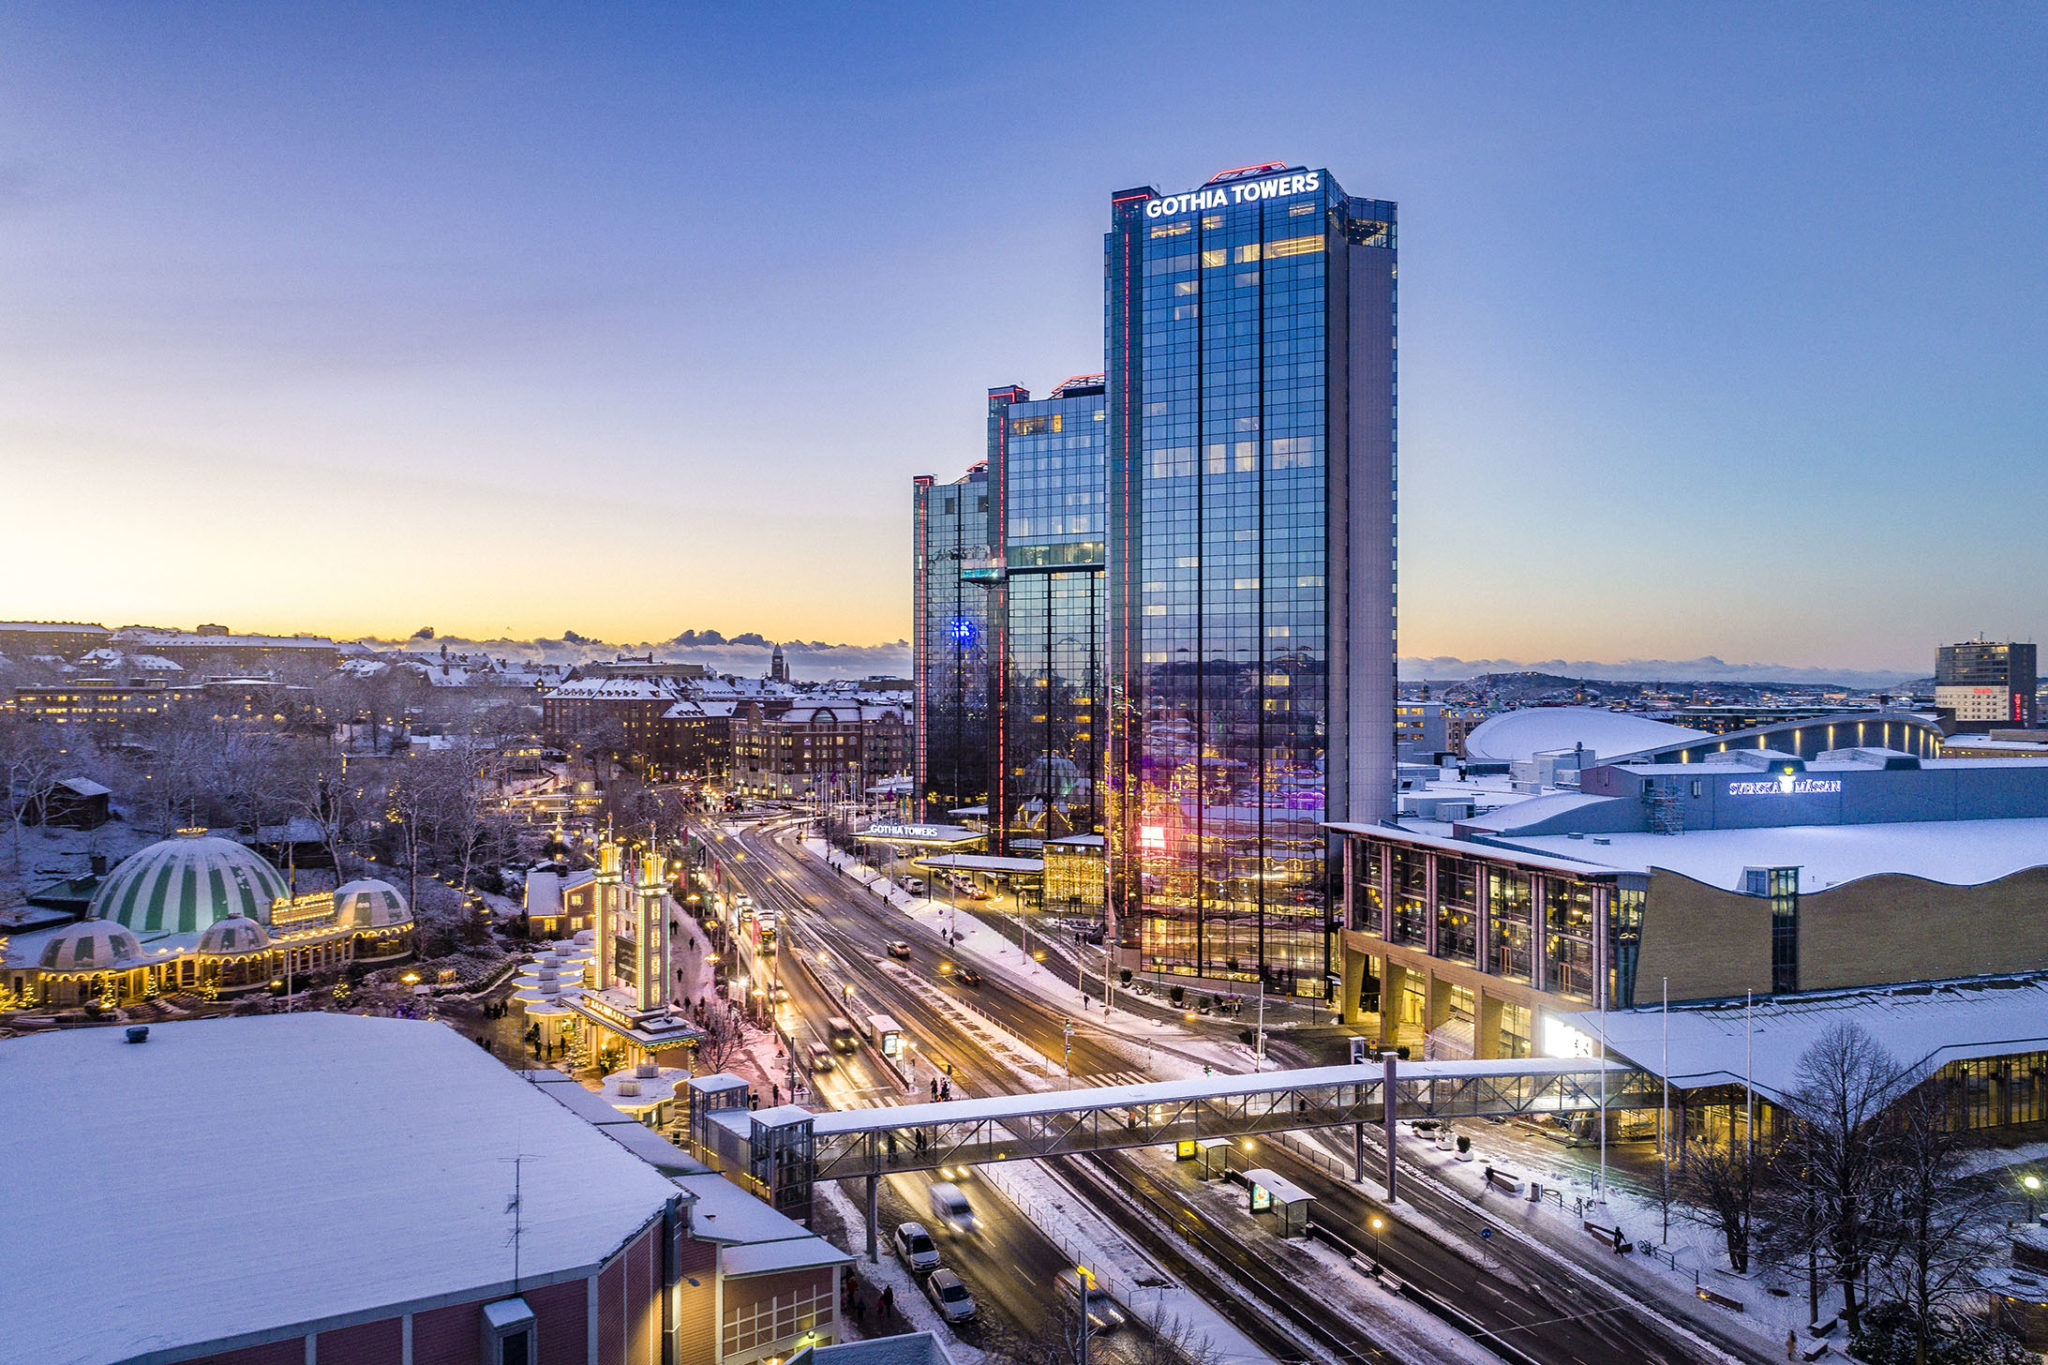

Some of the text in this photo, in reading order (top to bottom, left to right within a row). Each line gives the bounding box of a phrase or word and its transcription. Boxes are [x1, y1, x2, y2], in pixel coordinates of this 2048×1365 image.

[1146, 172, 1320, 218] GOTHIA TOWERS
[1729, 782, 1782, 795] SVENSKA
[870, 824, 938, 836] GOTHIA TOWERS
